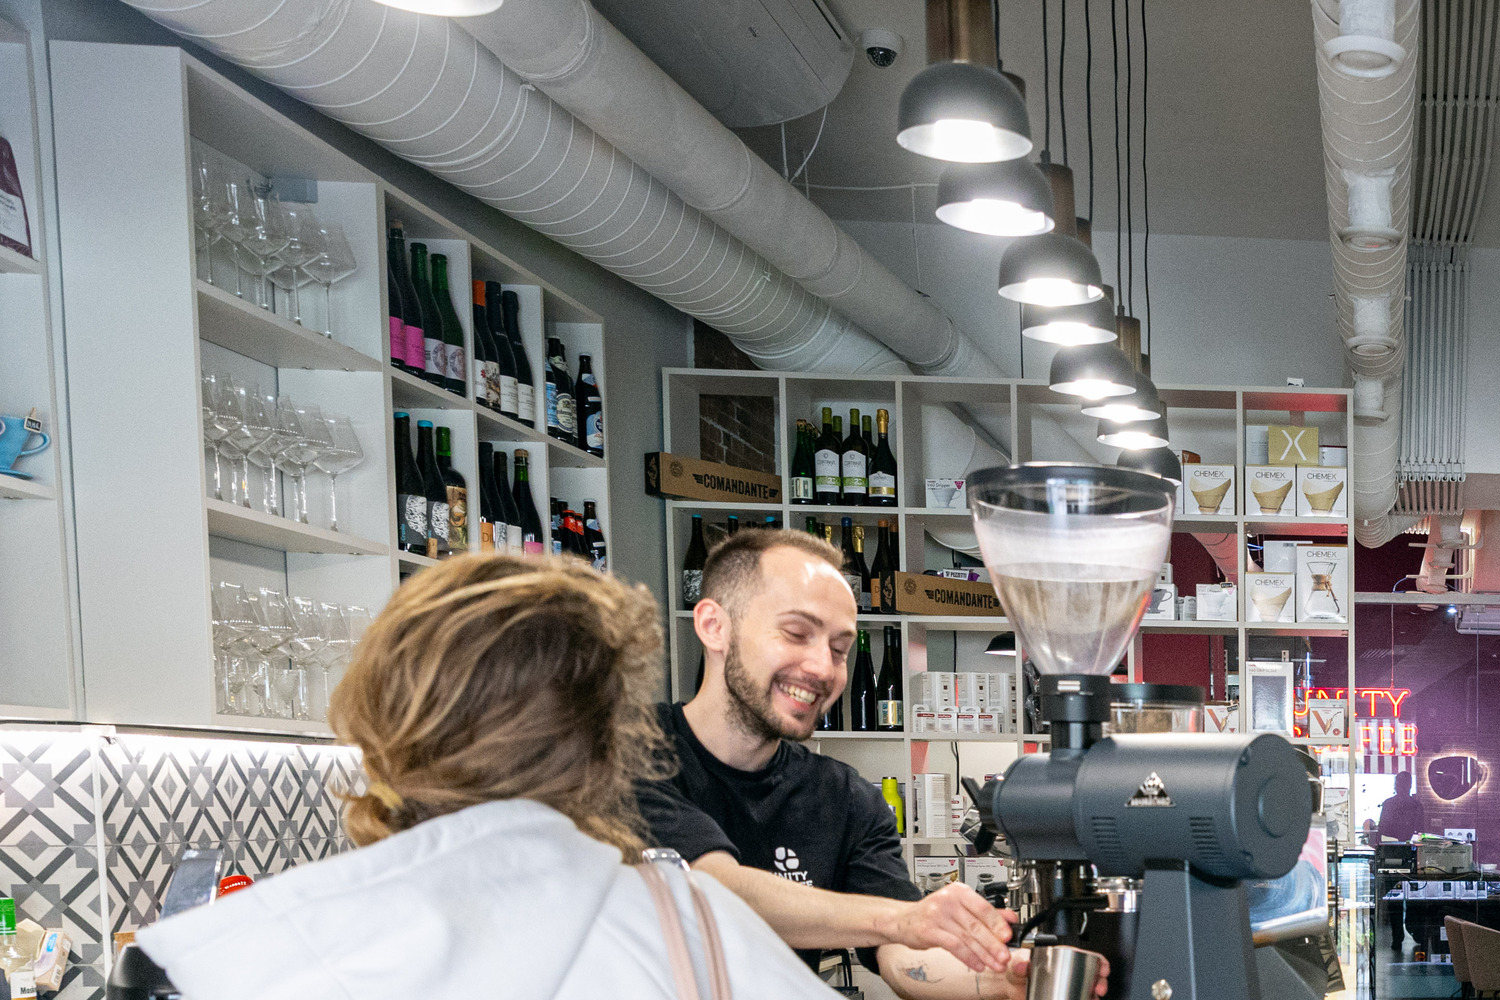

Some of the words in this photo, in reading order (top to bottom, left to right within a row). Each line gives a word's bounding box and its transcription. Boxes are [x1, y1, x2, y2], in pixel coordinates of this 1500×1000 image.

[1193, 470, 1225, 478] CHEMEX
[1255, 471, 1286, 479] CHEMEX
[1306, 472, 1337, 480] CHEMEX
[703, 473, 769, 500] COMANDANTE
[1306, 550, 1337, 558] CHEMEX
[1254, 578, 1285, 586] CHEMEX
[934, 588, 994, 610] COMANDANTE
[1294, 688, 1410, 717] UTY
[771, 870, 809, 882] NITY
